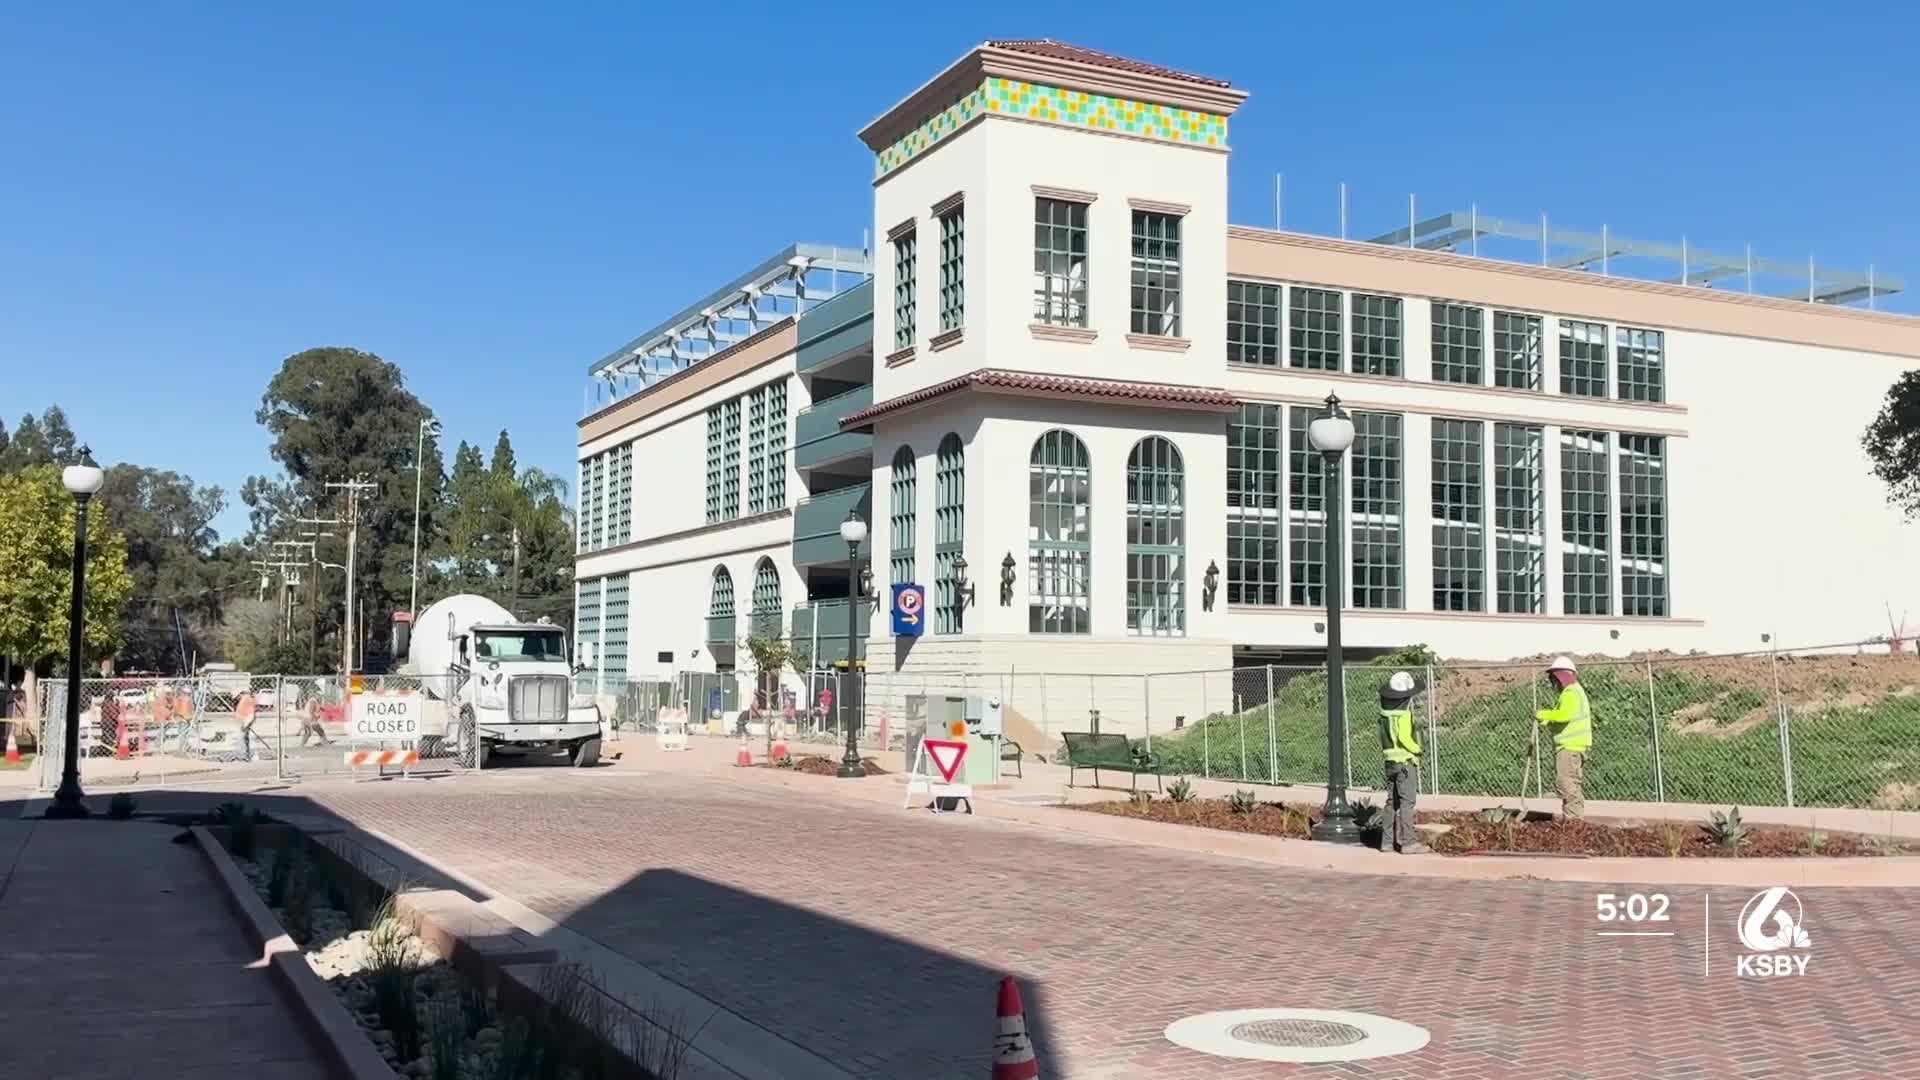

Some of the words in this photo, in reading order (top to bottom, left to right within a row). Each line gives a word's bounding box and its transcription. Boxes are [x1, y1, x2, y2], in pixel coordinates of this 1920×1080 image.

[905, 595, 916, 608] P
[367, 703, 407, 715] ROAD
[357, 720, 416, 733] CLOSED
